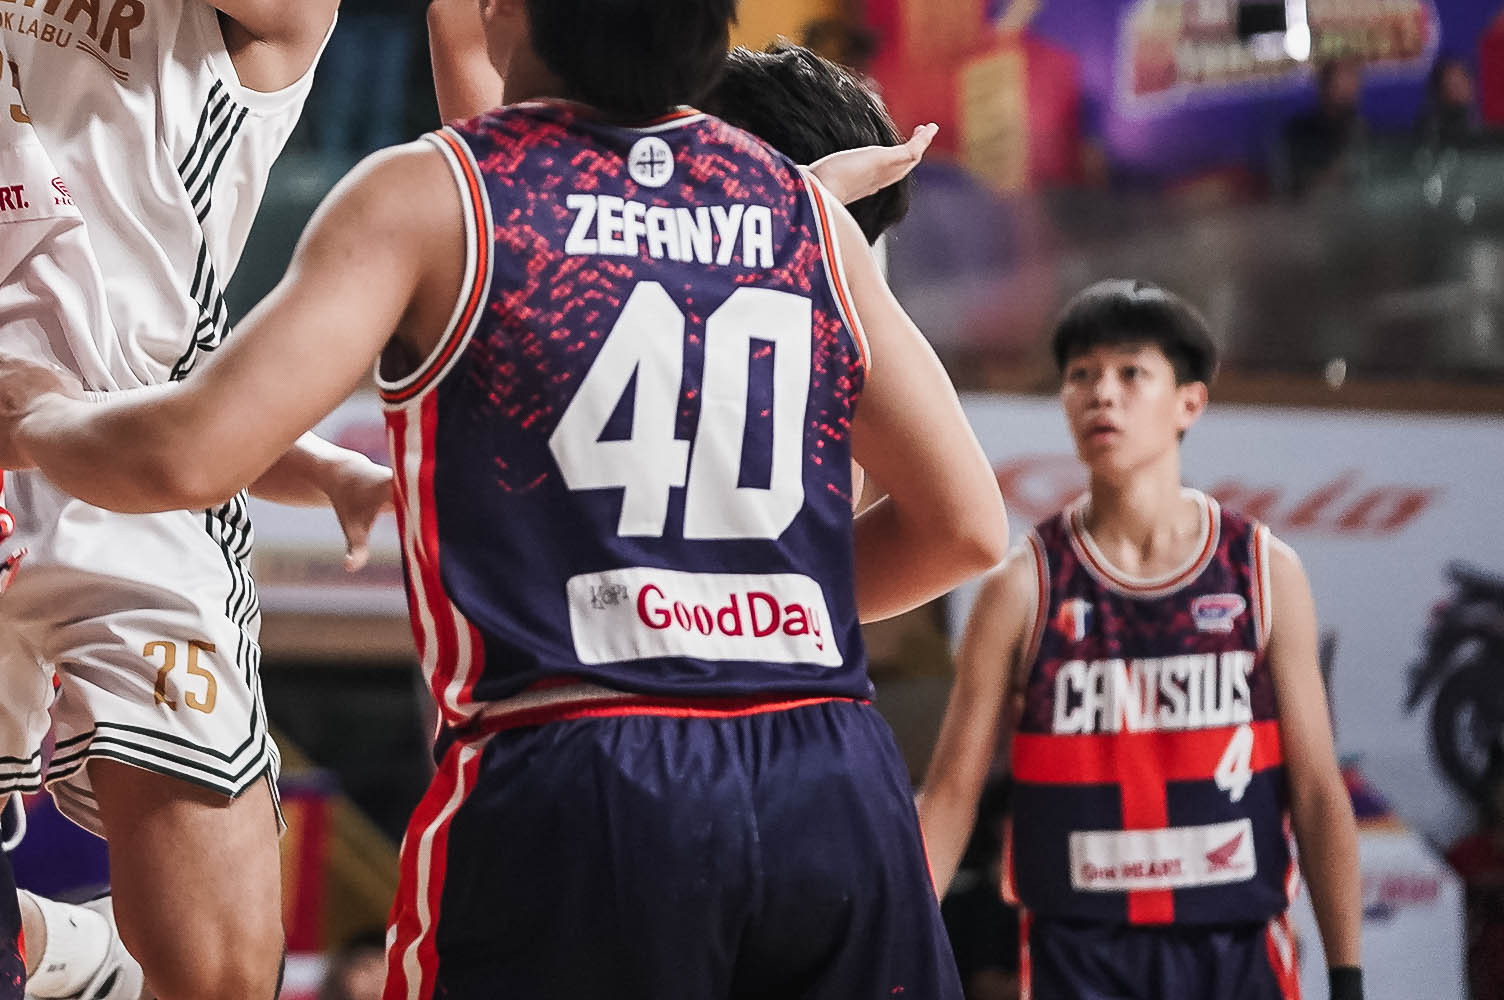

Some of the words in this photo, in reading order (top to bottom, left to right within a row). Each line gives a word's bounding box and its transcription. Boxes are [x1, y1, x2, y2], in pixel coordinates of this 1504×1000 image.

[18, 14, 73, 48] LABU
[564, 194, 774, 269] ZEFANYA
[548, 280, 814, 541] 40
[142, 640, 217, 714] 25
[1052, 650, 1256, 735] CANISIUS
[1214, 723, 1254, 803] 4
